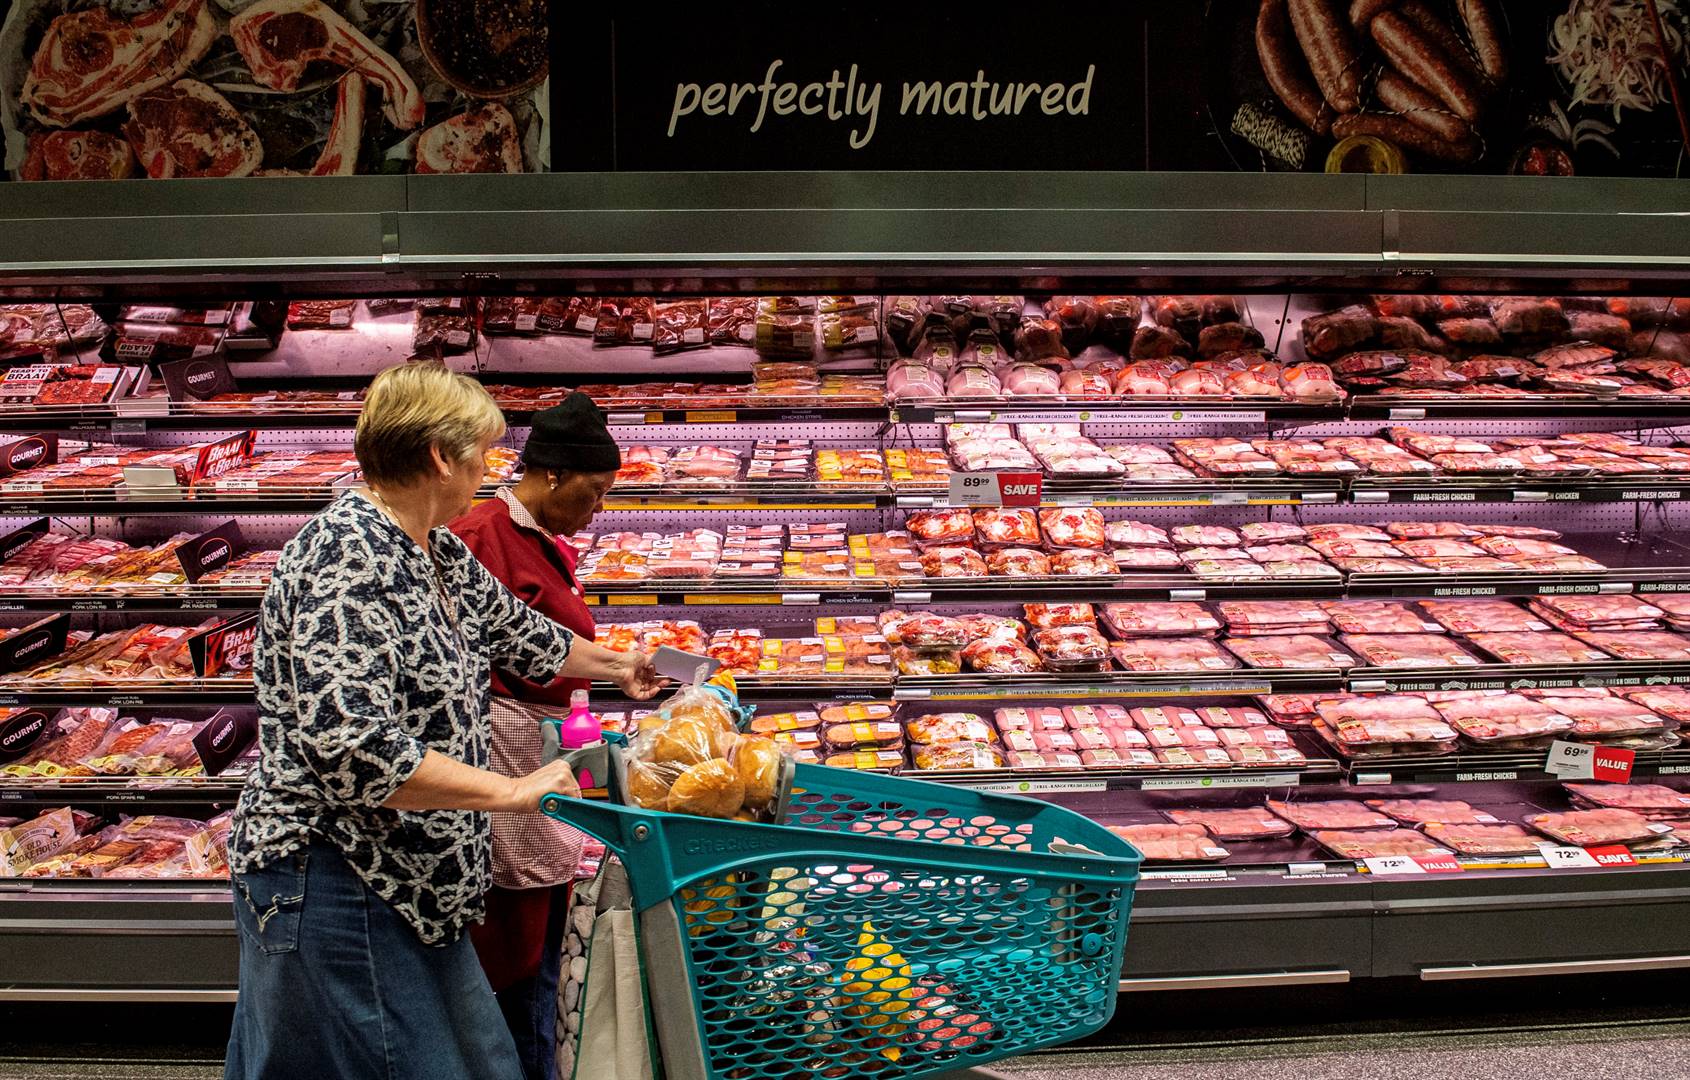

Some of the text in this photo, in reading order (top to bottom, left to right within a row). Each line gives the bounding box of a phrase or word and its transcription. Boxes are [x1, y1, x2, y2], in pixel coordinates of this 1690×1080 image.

[667, 59, 1095, 150] perfectly matured
[187, 371, 216, 384] GOURMET
[12, 446, 44, 463] GOURMET
[207, 440, 242, 465] BRAAI
[1003, 484, 1037, 496] SAVE
[1555, 492, 1580, 500] CHICKEN
[1622, 491, 1681, 500] FARM-FRESH CHICKEN
[1413, 493, 1475, 501] FARM-FRESH CHICKEN
[201, 545, 228, 566] GOURMET
[1434, 587, 1496, 596] FARM-FRESH CHICKEN
[1539, 585, 1599, 594] FARM-FRESH CHICKEN
[14, 637, 48, 658] GOURMET
[3, 719, 43, 746] GOURMET
[212, 720, 234, 747] GOURMET
[1596, 757, 1629, 770] VALUE
[1457, 772, 1517, 781] FARM-FRESH CHICKEN
[27, 840, 42, 850] OLD
[1597, 854, 1633, 864] SAVE
[1421, 862, 1458, 870] VALUE
